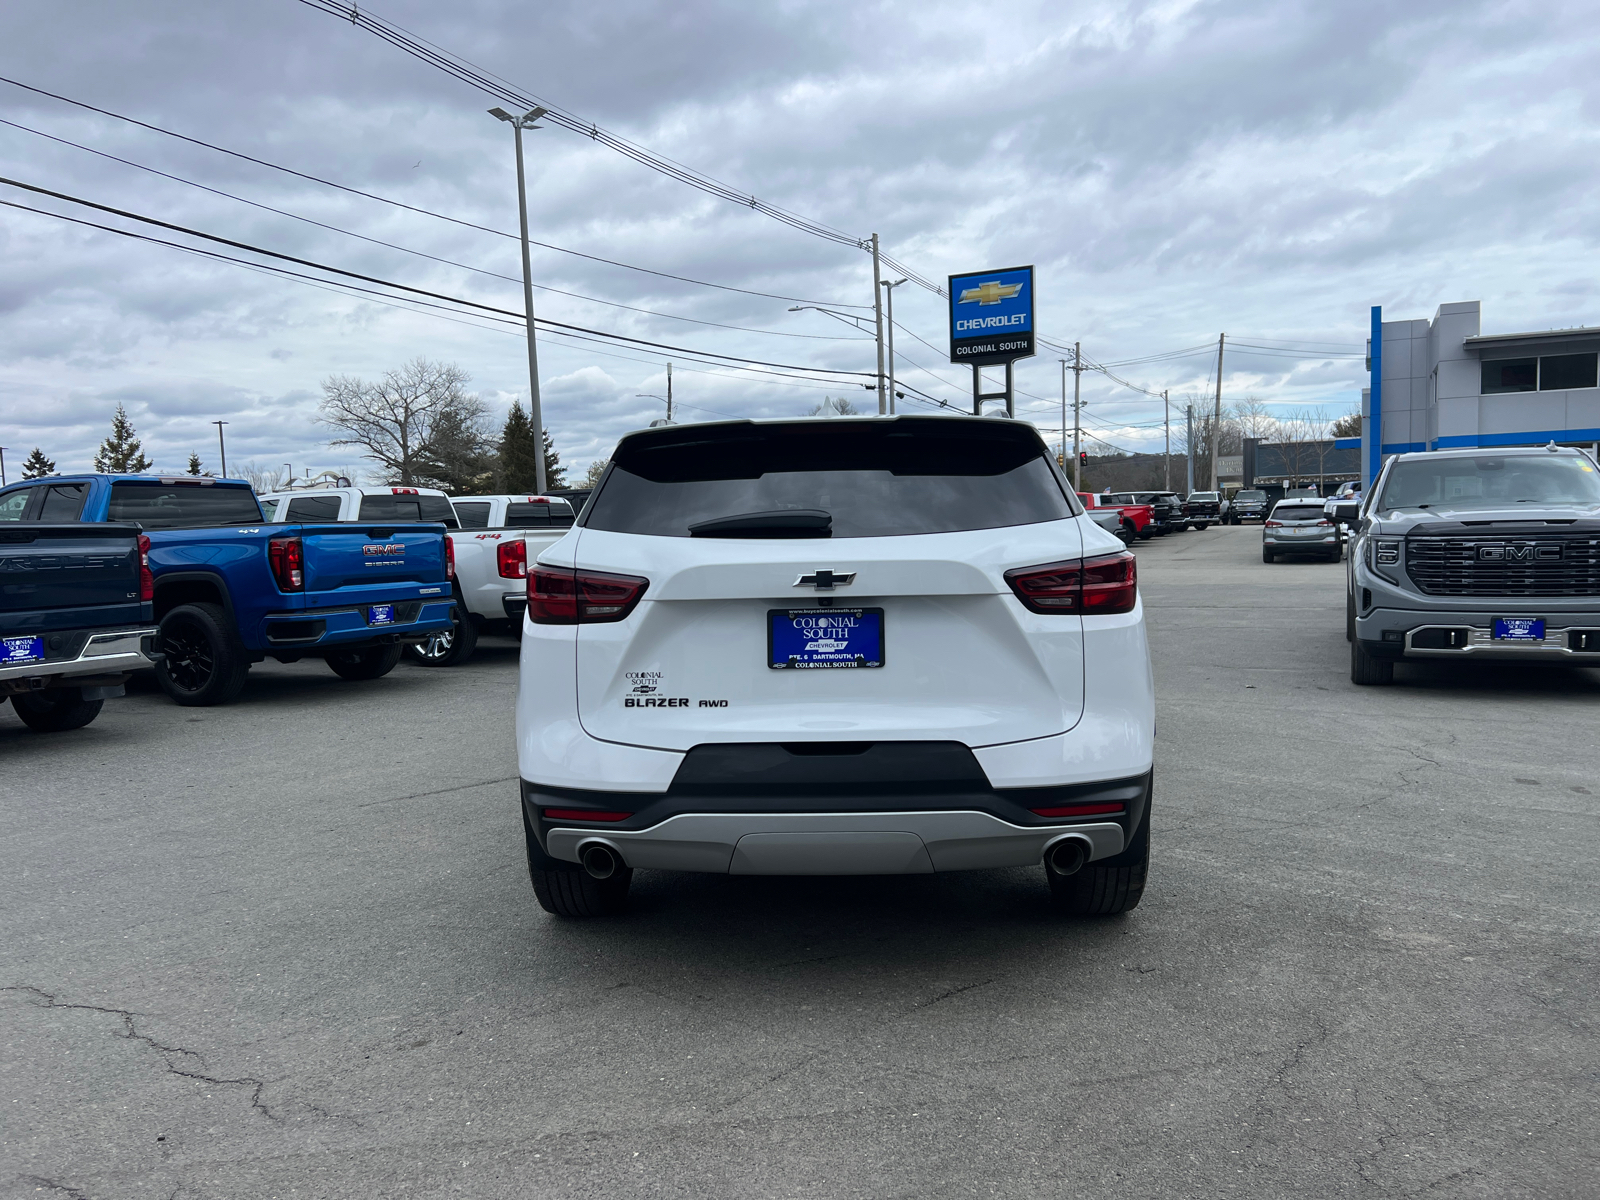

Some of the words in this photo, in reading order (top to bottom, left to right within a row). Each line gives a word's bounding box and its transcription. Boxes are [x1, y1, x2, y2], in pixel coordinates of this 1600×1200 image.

[956, 313, 1027, 331] CHEVROLET
[956, 344, 997, 355] COLONIAL
[999, 340, 1028, 351] SOUTH
[363, 544, 406, 556] GMC
[1480, 546, 1560, 560] GMC
[793, 617, 859, 629] COLONIAL
[803, 628, 849, 639] SOUTH
[625, 671, 664, 679] COLONIAL
[631, 678, 658, 686] SOUTH
[624, 698, 690, 708] BLAZER
[698, 699, 729, 708] AWD
